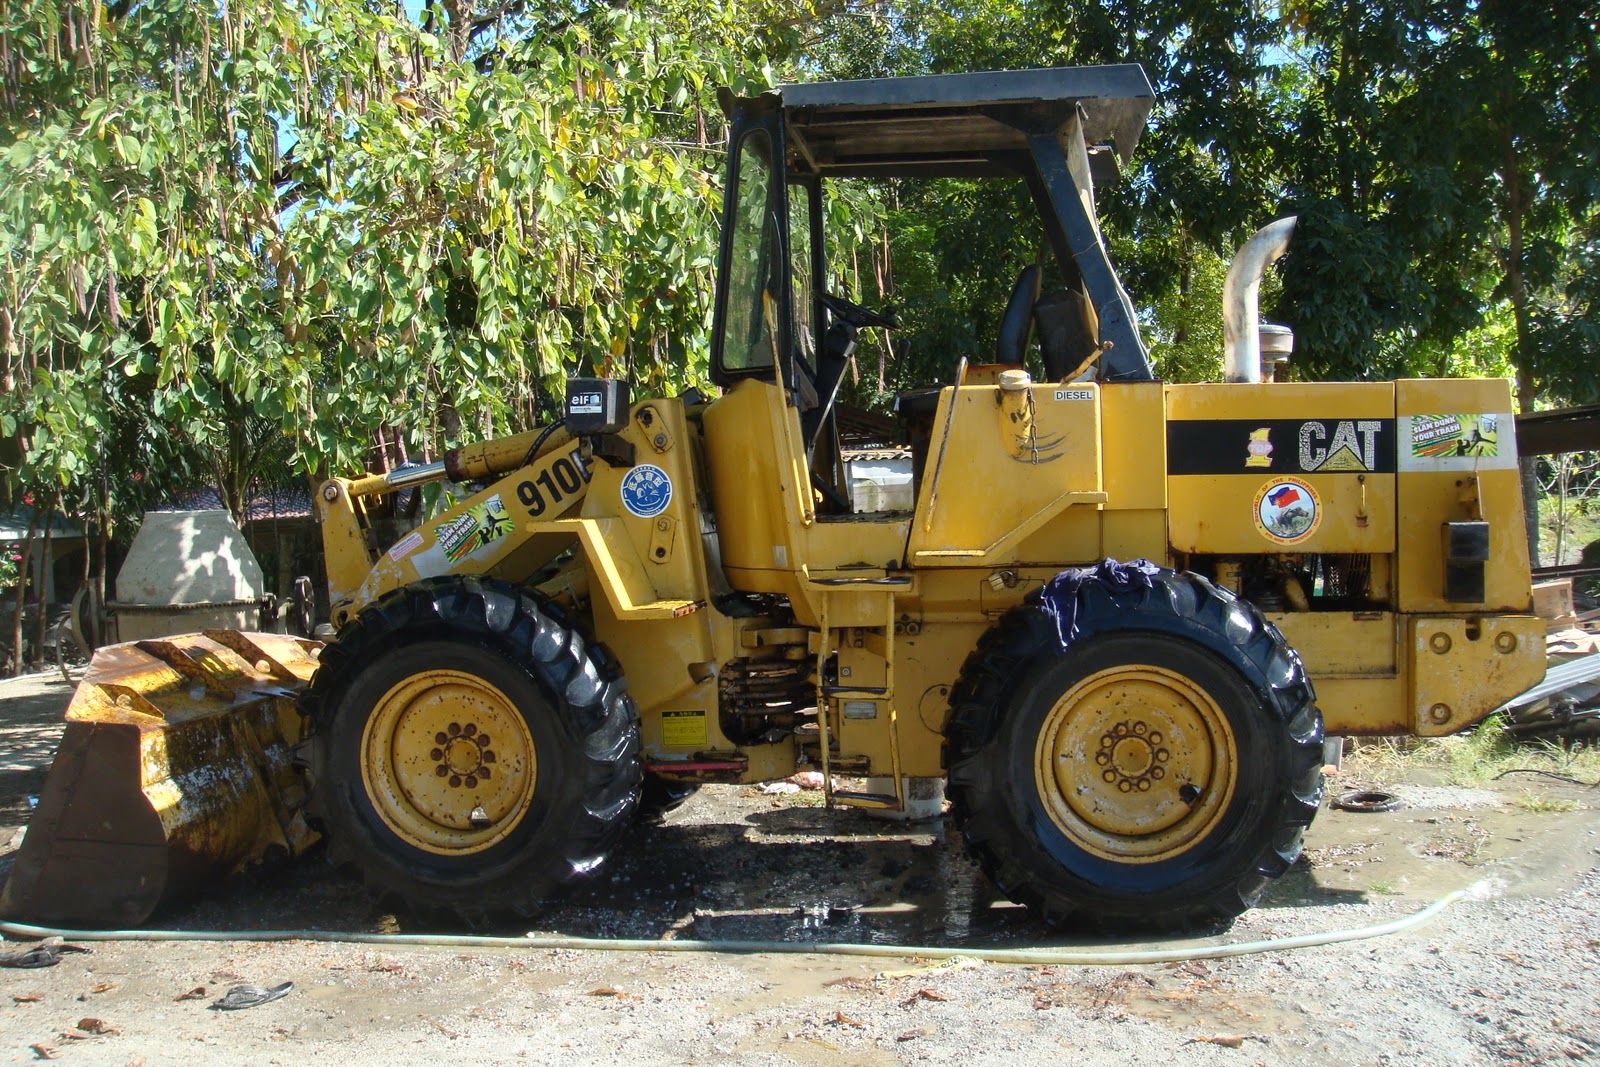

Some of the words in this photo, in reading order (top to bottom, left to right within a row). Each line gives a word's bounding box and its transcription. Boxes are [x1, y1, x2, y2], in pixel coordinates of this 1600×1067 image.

[571, 395, 589, 405] elf
[1056, 391, 1092, 400] DIESEL
[1414, 423, 1433, 433] SLAM
[1435, 416, 1455, 427] DUNK
[1414, 432, 1434, 442] YOUR
[1436, 424, 1460, 436] TRASH
[1299, 421, 1381, 471] CAT
[1254, 495, 1262, 523] REPUBLIC
[1262, 484, 1269, 492] OF
[1288, 477, 1318, 500] PHILIPPINES
[440, 528, 455, 542] SLAM
[453, 513, 470, 530] DUNK
[443, 534, 460, 550] YOUR
[457, 517, 477, 536] TRASH
